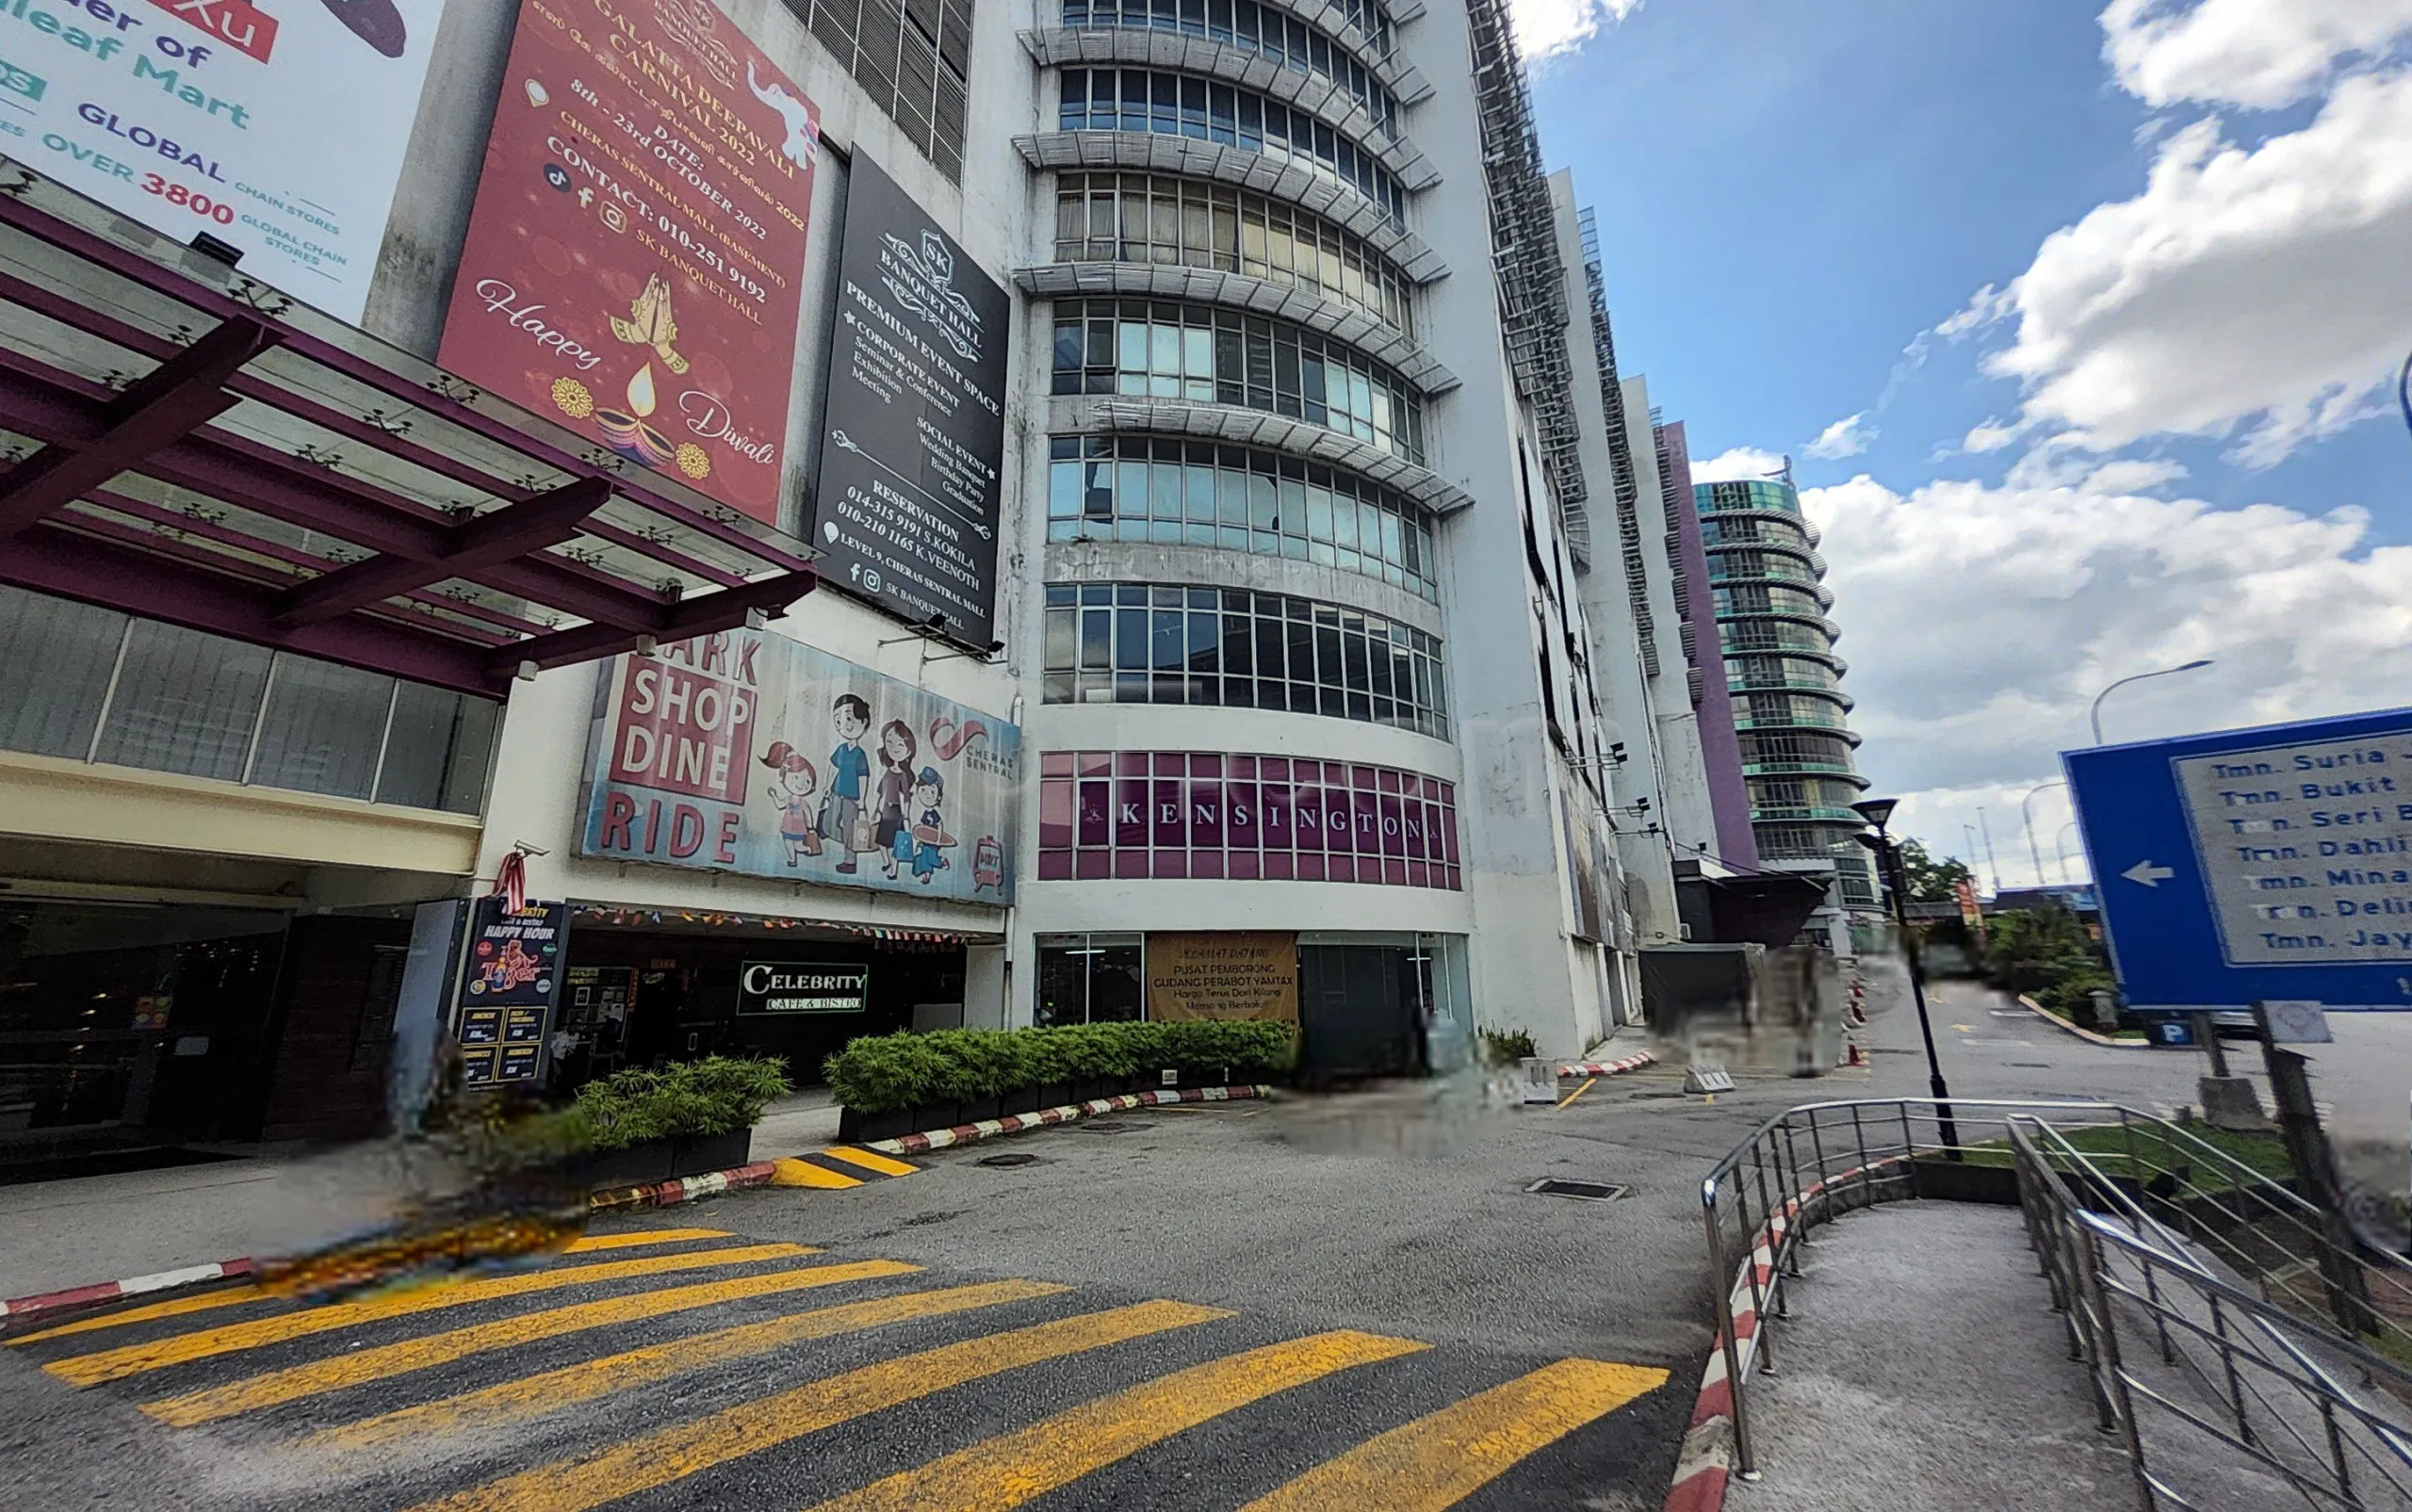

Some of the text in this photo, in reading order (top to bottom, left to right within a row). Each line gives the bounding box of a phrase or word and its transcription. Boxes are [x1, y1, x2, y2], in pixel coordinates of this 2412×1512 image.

[64, 0, 213, 68] er of
[132, 54, 249, 130] Mart
[595, 0, 794, 180] GALATTA DEEPAVALI
[610, 34, 756, 167] CARNIVAL 2022
[78, 103, 340, 235] GLOBAL CHAIN STORES
[570, 79, 598, 107] 8th
[612, 112, 652, 148] 23rd
[653, 145, 734, 214] OCTOBER
[735, 210, 768, 241] 2022
[653, 123, 706, 171] DATE:
[42, 133, 134, 182] OVER
[140, 171, 234, 225] 3800
[241, 214, 300, 245] GLOBAL
[302, 241, 348, 266] CHAIN
[547, 136, 768, 304] CONTACT: 010-251 9192
[560, 110, 787, 289] CHERAS SENTRAL MALL (BASEMENT)
[775, 201, 806, 233] 2022
[265, 236, 320, 266] STORES
[635, 228, 763, 326] SK BANQUET HALL
[925, 242, 949, 273] SK
[476, 279, 603, 370] Happy
[880, 249, 983, 349] BANQUET HALL
[846, 279, 1000, 417] PREMIUM EVENT SPACE
[853, 350, 903, 395] Exhibition
[855, 334, 894, 372] Seminar
[905, 375, 953, 417] Conference
[856, 320, 961, 409] CORPORATE EVENT
[851, 366, 892, 404] Meeting
[678, 390, 775, 465] Diwali
[916, 415, 986, 474] SOCIAL EVENT
[919, 432, 986, 488] Wedding Banquet
[930, 456, 986, 503] Birthday Party
[872, 479, 960, 543] RESERVATION
[942, 480, 985, 516] Graduation
[838, 500, 981, 592] 010-210 1165 K.VEENOTH
[846, 485, 976, 572] 014-315 9191 S.KOKILA
[840, 532, 876, 561] LEVEL
[885, 556, 923, 586] CHERAS
[923, 574, 963, 607] SENTRAL
[962, 600, 986, 619] MALL
[885, 581, 966, 630] SK BANQUET ALL
[663, 633, 761, 686] ARK
[630, 668, 749, 739] SHOP
[622, 724, 730, 791] DINE
[966, 744, 1014, 769] CHERAS
[966, 756, 1014, 781] SENTRAL
[2211, 750, 2386, 779] Tmn. Suria
[2300, 776, 2395, 799] Bukit
[600, 791, 740, 865] RIDE
[1120, 802, 1422, 838] KENSINGTON
[2225, 818, 2300, 834] Tn.
[2310, 806, 2383, 828] Seri
[483, 925, 555, 940] HAPPY HOUR
[2336, 896, 2412, 918] Deli
[2259, 932, 2337, 949] Tmn.
[743, 964, 868, 994] CELEBRITY
[1154, 978, 1201, 987] GUDANG
[1203, 977, 1251, 986] PERABOT
[1174, 964, 1275, 975] PUSAT PEMBORONG
[767, 998, 804, 1010] CAFE
[821, 998, 862, 1009] BISTRO
[2162, 1024, 2184, 1043] P
